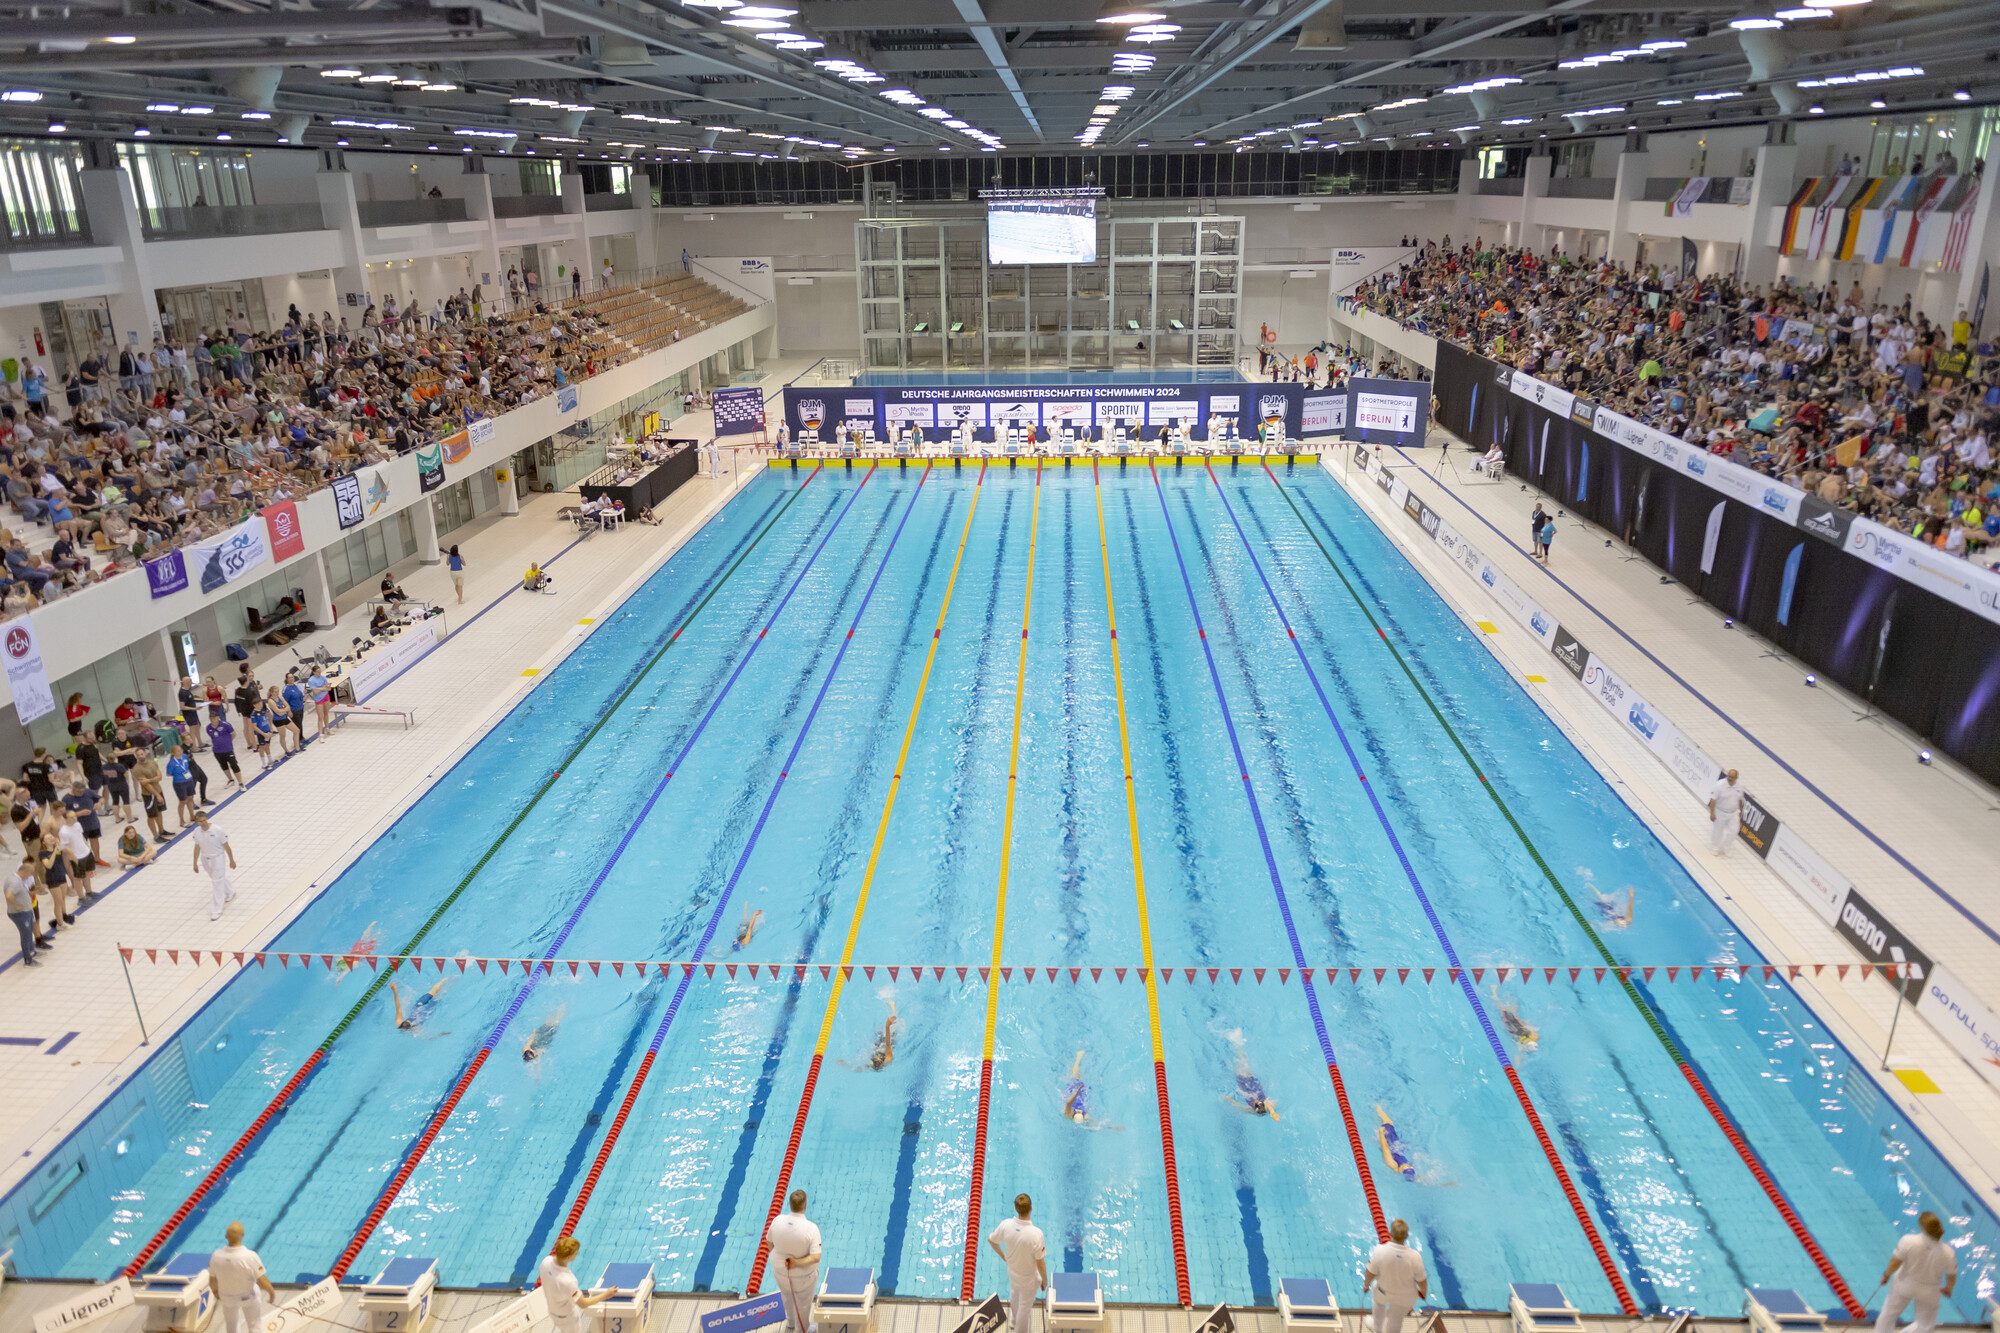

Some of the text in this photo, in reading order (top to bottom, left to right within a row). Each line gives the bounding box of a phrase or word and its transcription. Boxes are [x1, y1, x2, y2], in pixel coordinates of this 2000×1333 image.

[901, 388, 1181, 399] DEUTSCHE JAHRGANGSMEISTERSCHAFTEN SCHWIMMEN 2024
[1263, 396, 1284, 404] DJM
[801, 400, 821, 408] DJM
[1101, 404, 1139, 416] SPORTIV
[1301, 416, 1328, 426] BERLIN
[1360, 413, 1392, 424] BERLIN
[9, 637, 29, 654] FCN
[1554, 645, 1582, 673] aquafeel
[1605, 675, 1624, 699] Myrtha
[1601, 686, 1616, 707] Pools
[1742, 800, 1765, 832] RTIV
[1841, 902, 1887, 955] arena
[1931, 985, 2000, 1058] GO FULL spe
[298, 1286, 330, 1308] Myrtha
[169, 1306, 177, 1323] 1
[301, 1298, 326, 1316] Pools
[708, 1300, 779, 1328] GO FULL speedo
[386, 1311, 399, 1328] 2
[611, 1317, 622, 1333] 3
